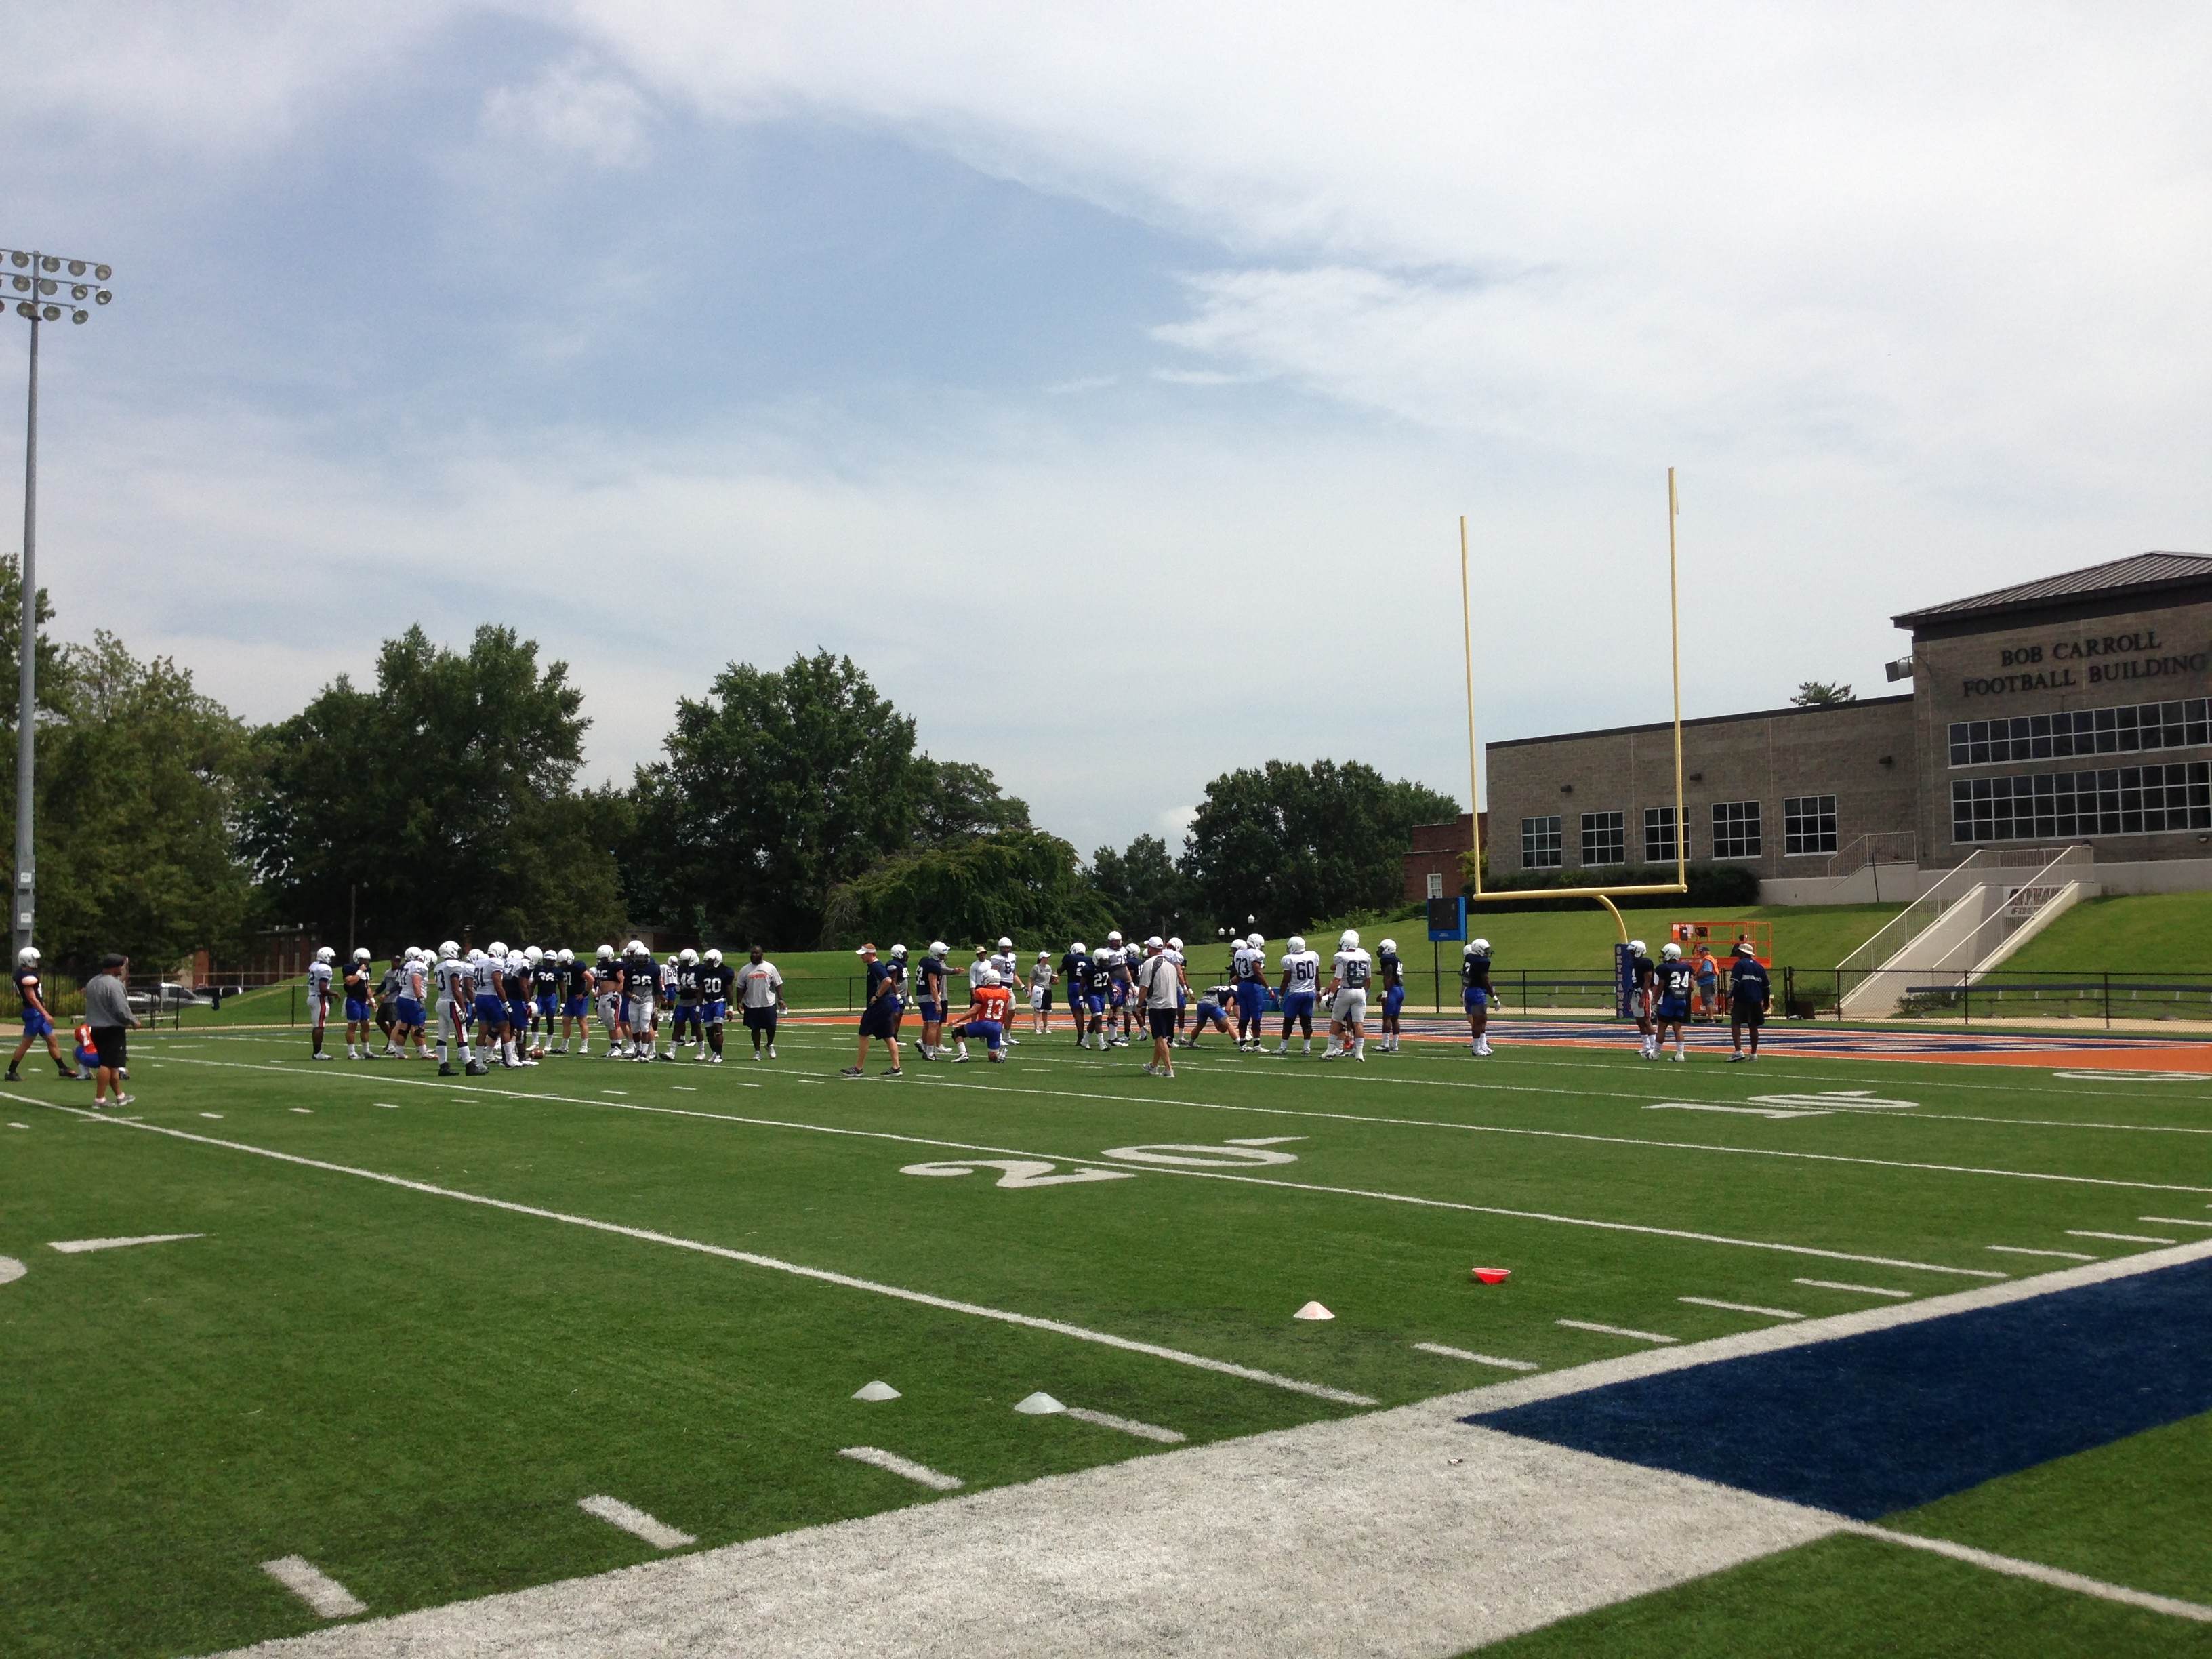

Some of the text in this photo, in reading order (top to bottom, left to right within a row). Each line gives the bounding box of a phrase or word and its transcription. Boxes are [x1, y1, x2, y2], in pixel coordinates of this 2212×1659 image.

[2001, 631, 2162, 667] BOB CARROLL
[1963, 653, 2207, 697] FOOTBALL BUILDING
[1235, 957, 1249, 975] 73
[1296, 960, 1315, 981] 60
[1347, 960, 1367, 977] 85
[703, 977, 722, 993] 20
[1094, 971, 1109, 987] 27
[1669, 971, 1689, 988] 24
[984, 999, 1004, 1020] 13
[899, 1144, 1300, 1189] 20
